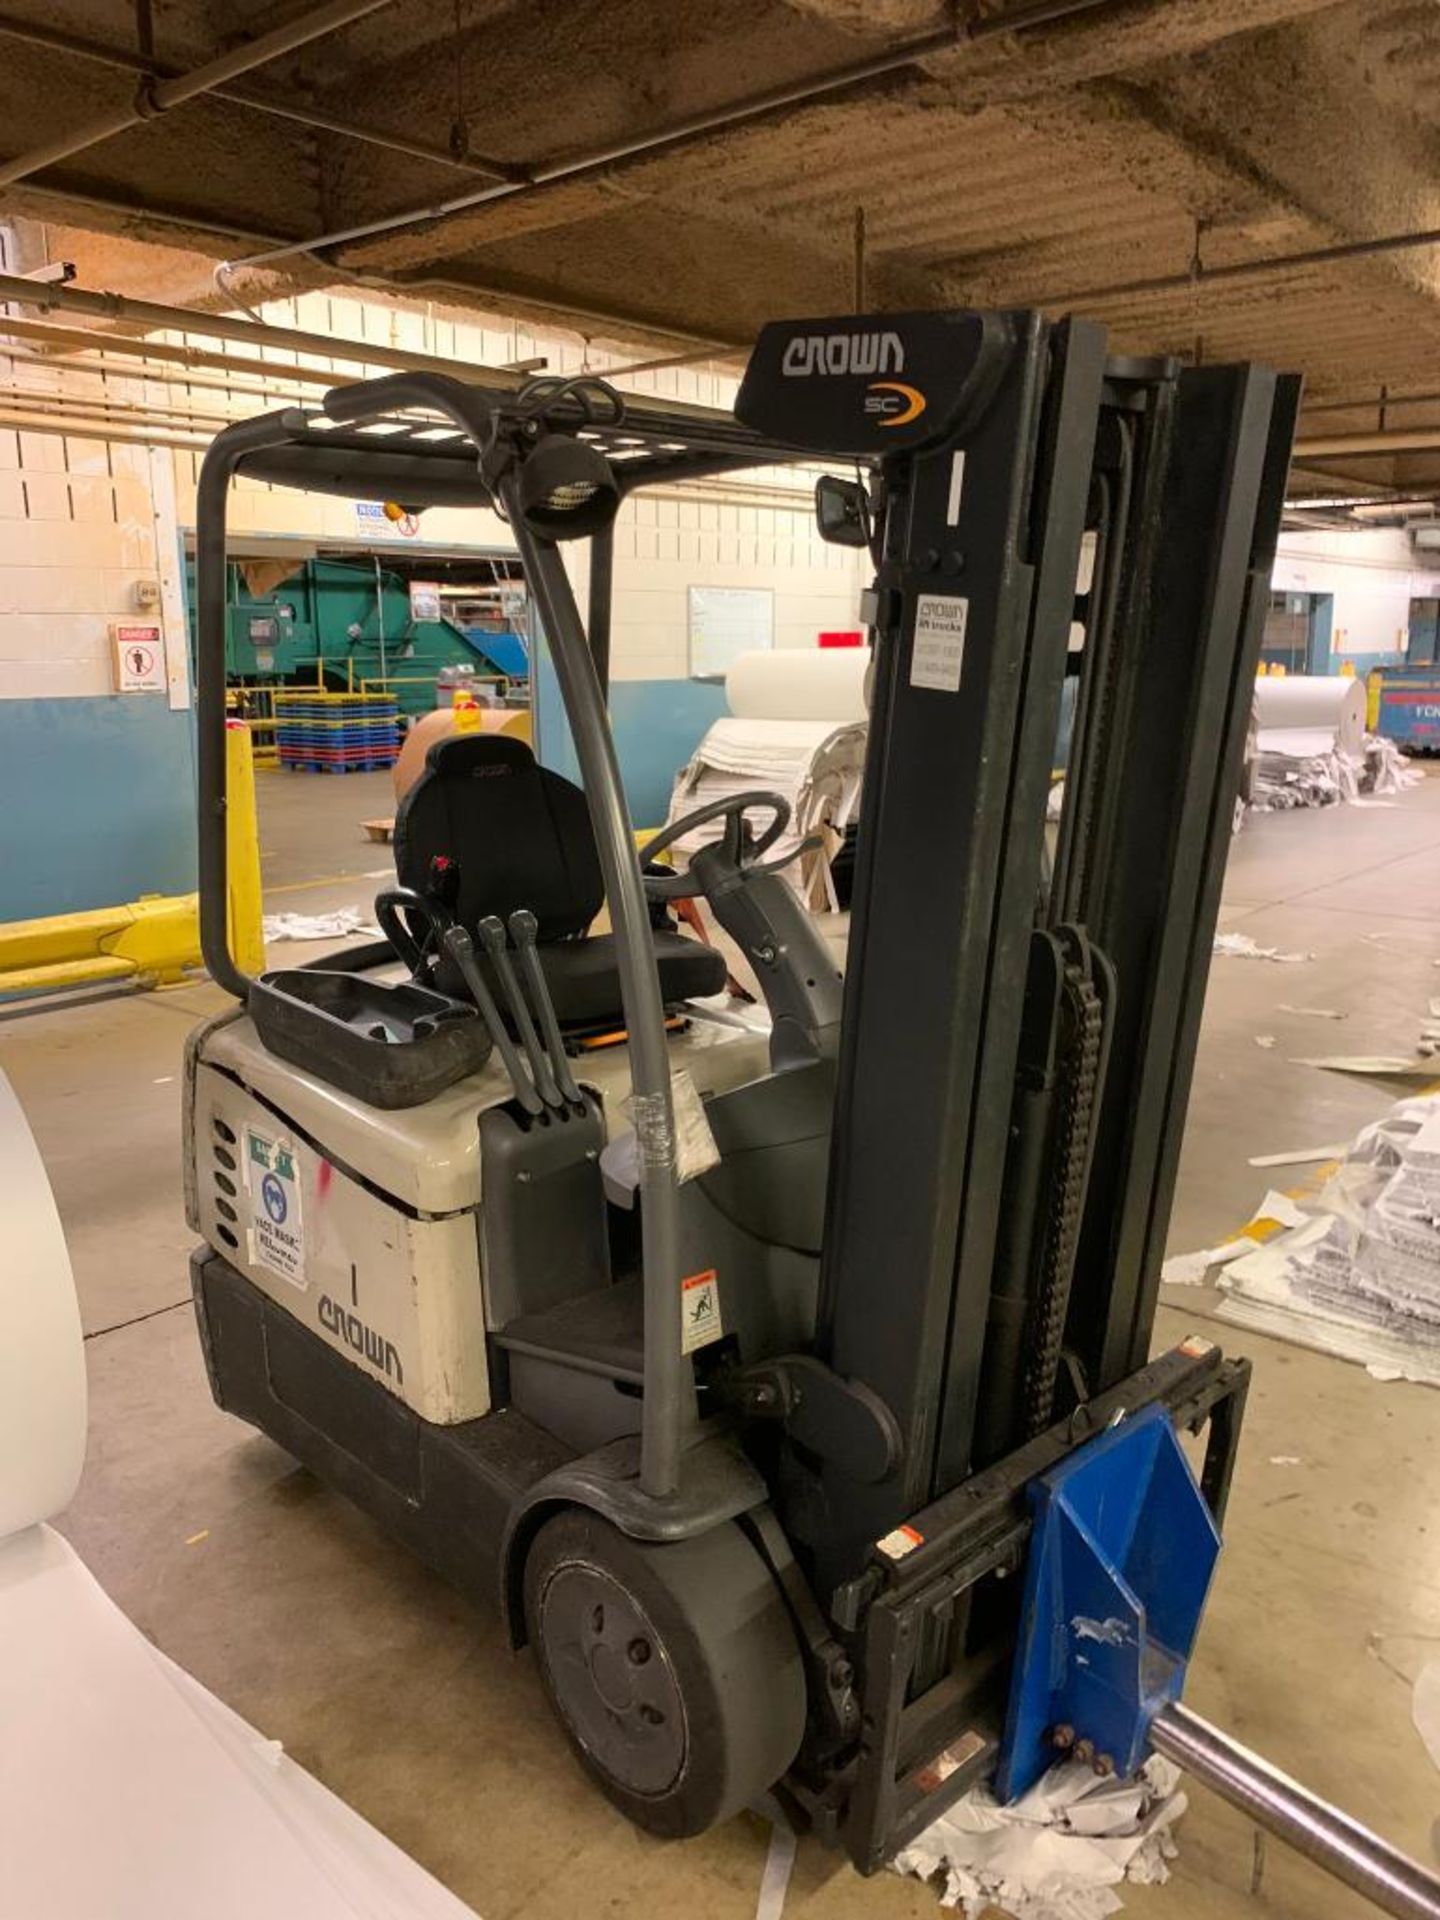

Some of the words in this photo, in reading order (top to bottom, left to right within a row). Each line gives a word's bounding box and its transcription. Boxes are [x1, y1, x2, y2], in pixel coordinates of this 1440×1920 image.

[782, 331, 904, 377] CROWN
[864, 396, 900, 414] SC
[920, 602, 963, 619] CROWN
[931, 621, 962, 632] trucks
[318, 1293, 404, 1387] CROWN
